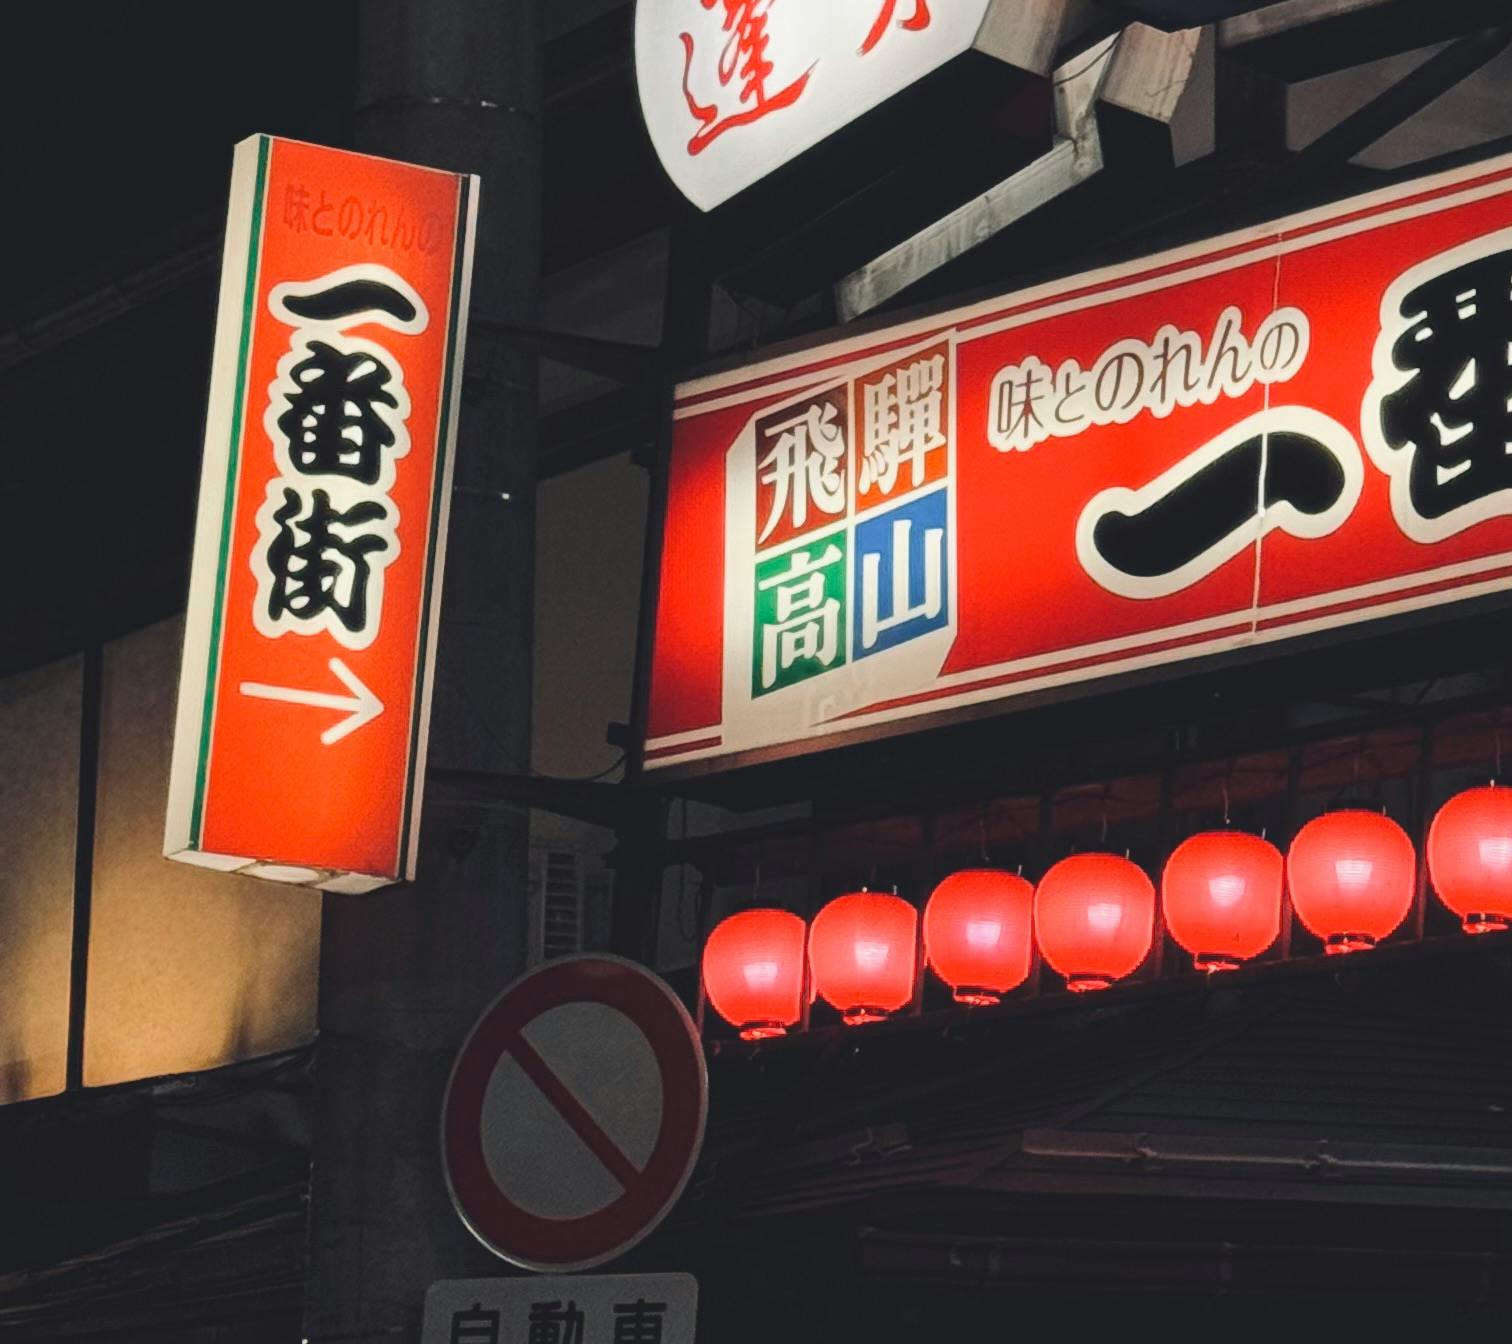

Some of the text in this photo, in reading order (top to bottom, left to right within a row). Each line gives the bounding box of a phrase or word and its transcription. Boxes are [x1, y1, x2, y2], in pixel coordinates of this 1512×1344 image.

[284, 184, 442, 256] 味とのれんの
[994, 314, 1304, 446] 味とのれんの
[265, 276, 420, 635] 一番街
